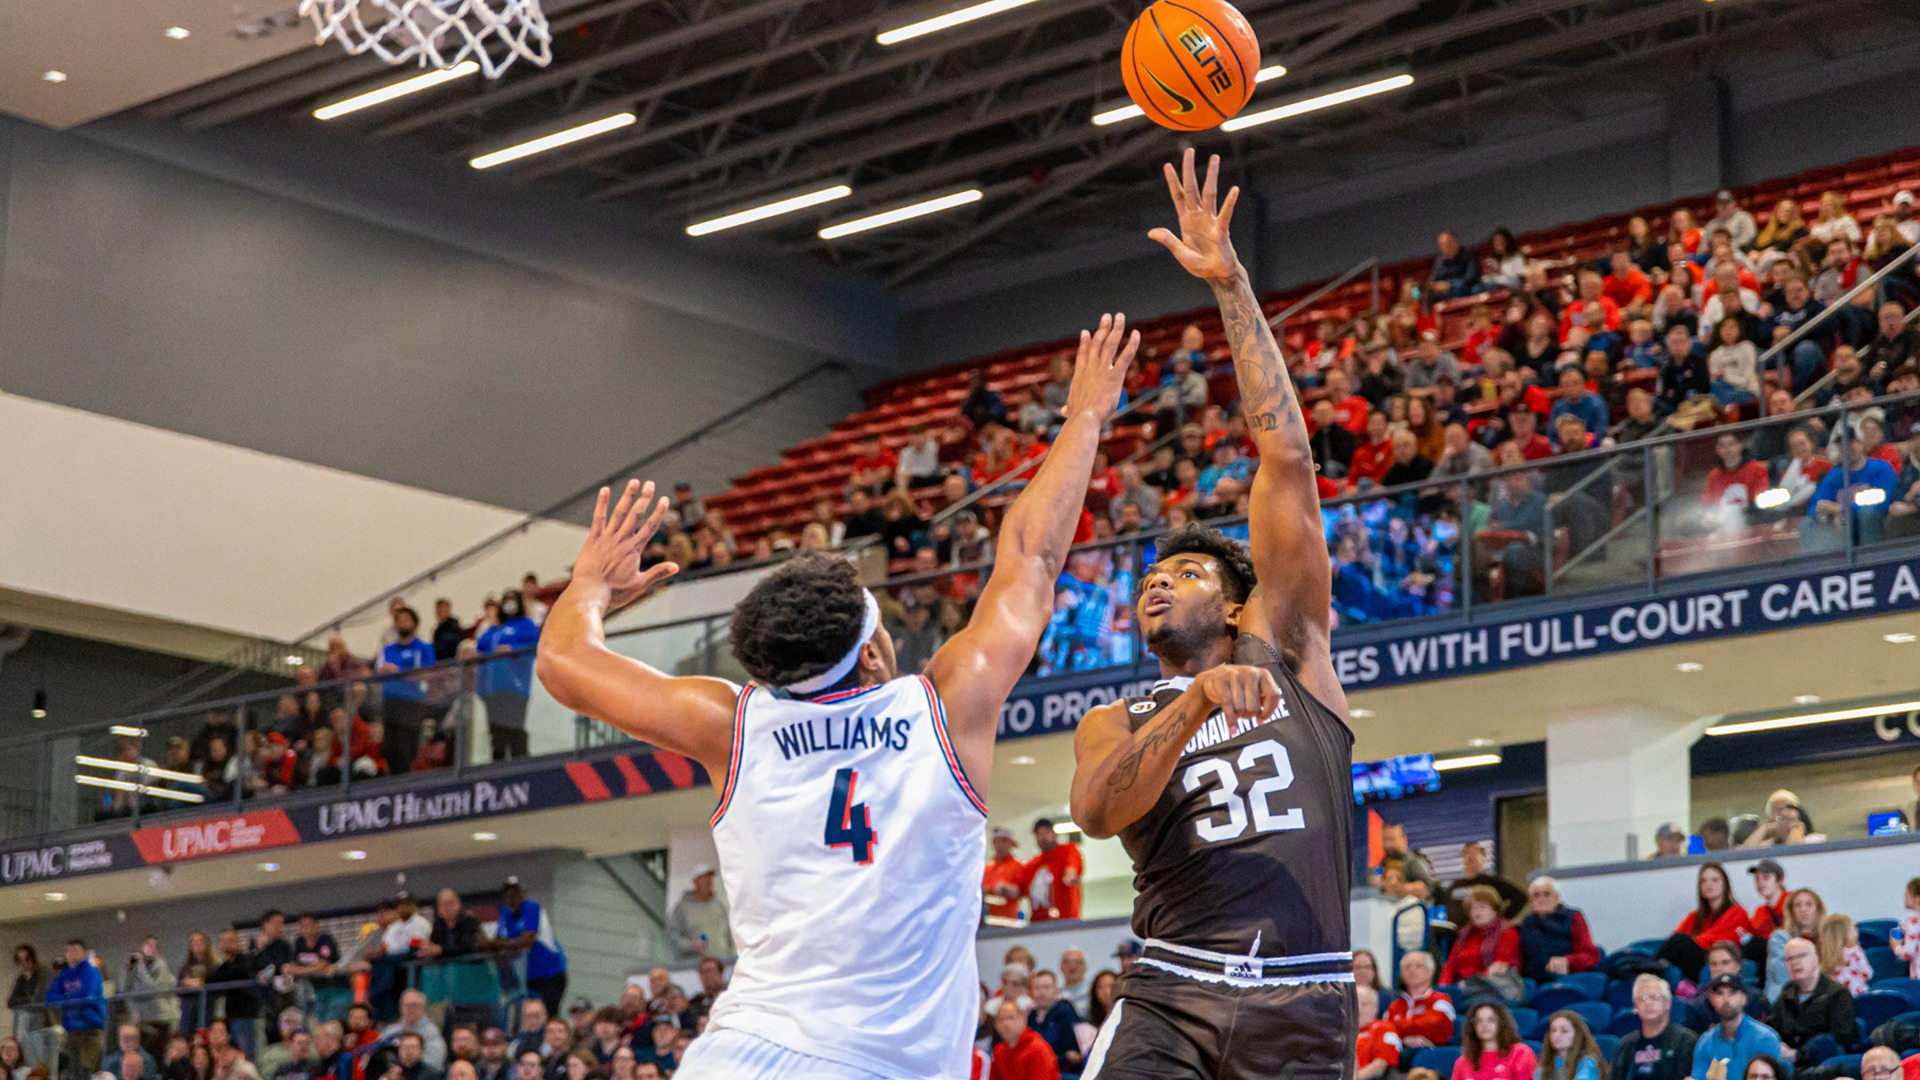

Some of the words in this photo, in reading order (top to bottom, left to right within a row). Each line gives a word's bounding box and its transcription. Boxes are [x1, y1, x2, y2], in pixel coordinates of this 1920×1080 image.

[1330, 645, 1380, 685] ES
[1388, 629, 1489, 677] WITH
[1499, 588, 1749, 662] FULL-COURT
[1760, 570, 1876, 622] CARE
[997, 698, 1036, 736] TO
[773, 717, 911, 761] WILLIAMS
[1182, 738, 1306, 843] 32
[318, 796, 392, 836] UPMC
[824, 768, 878, 866] 4
[162, 821, 231, 859] UPMC
[2, 846, 66, 882] UPMC
[1230, 970, 1257, 979] adidas
